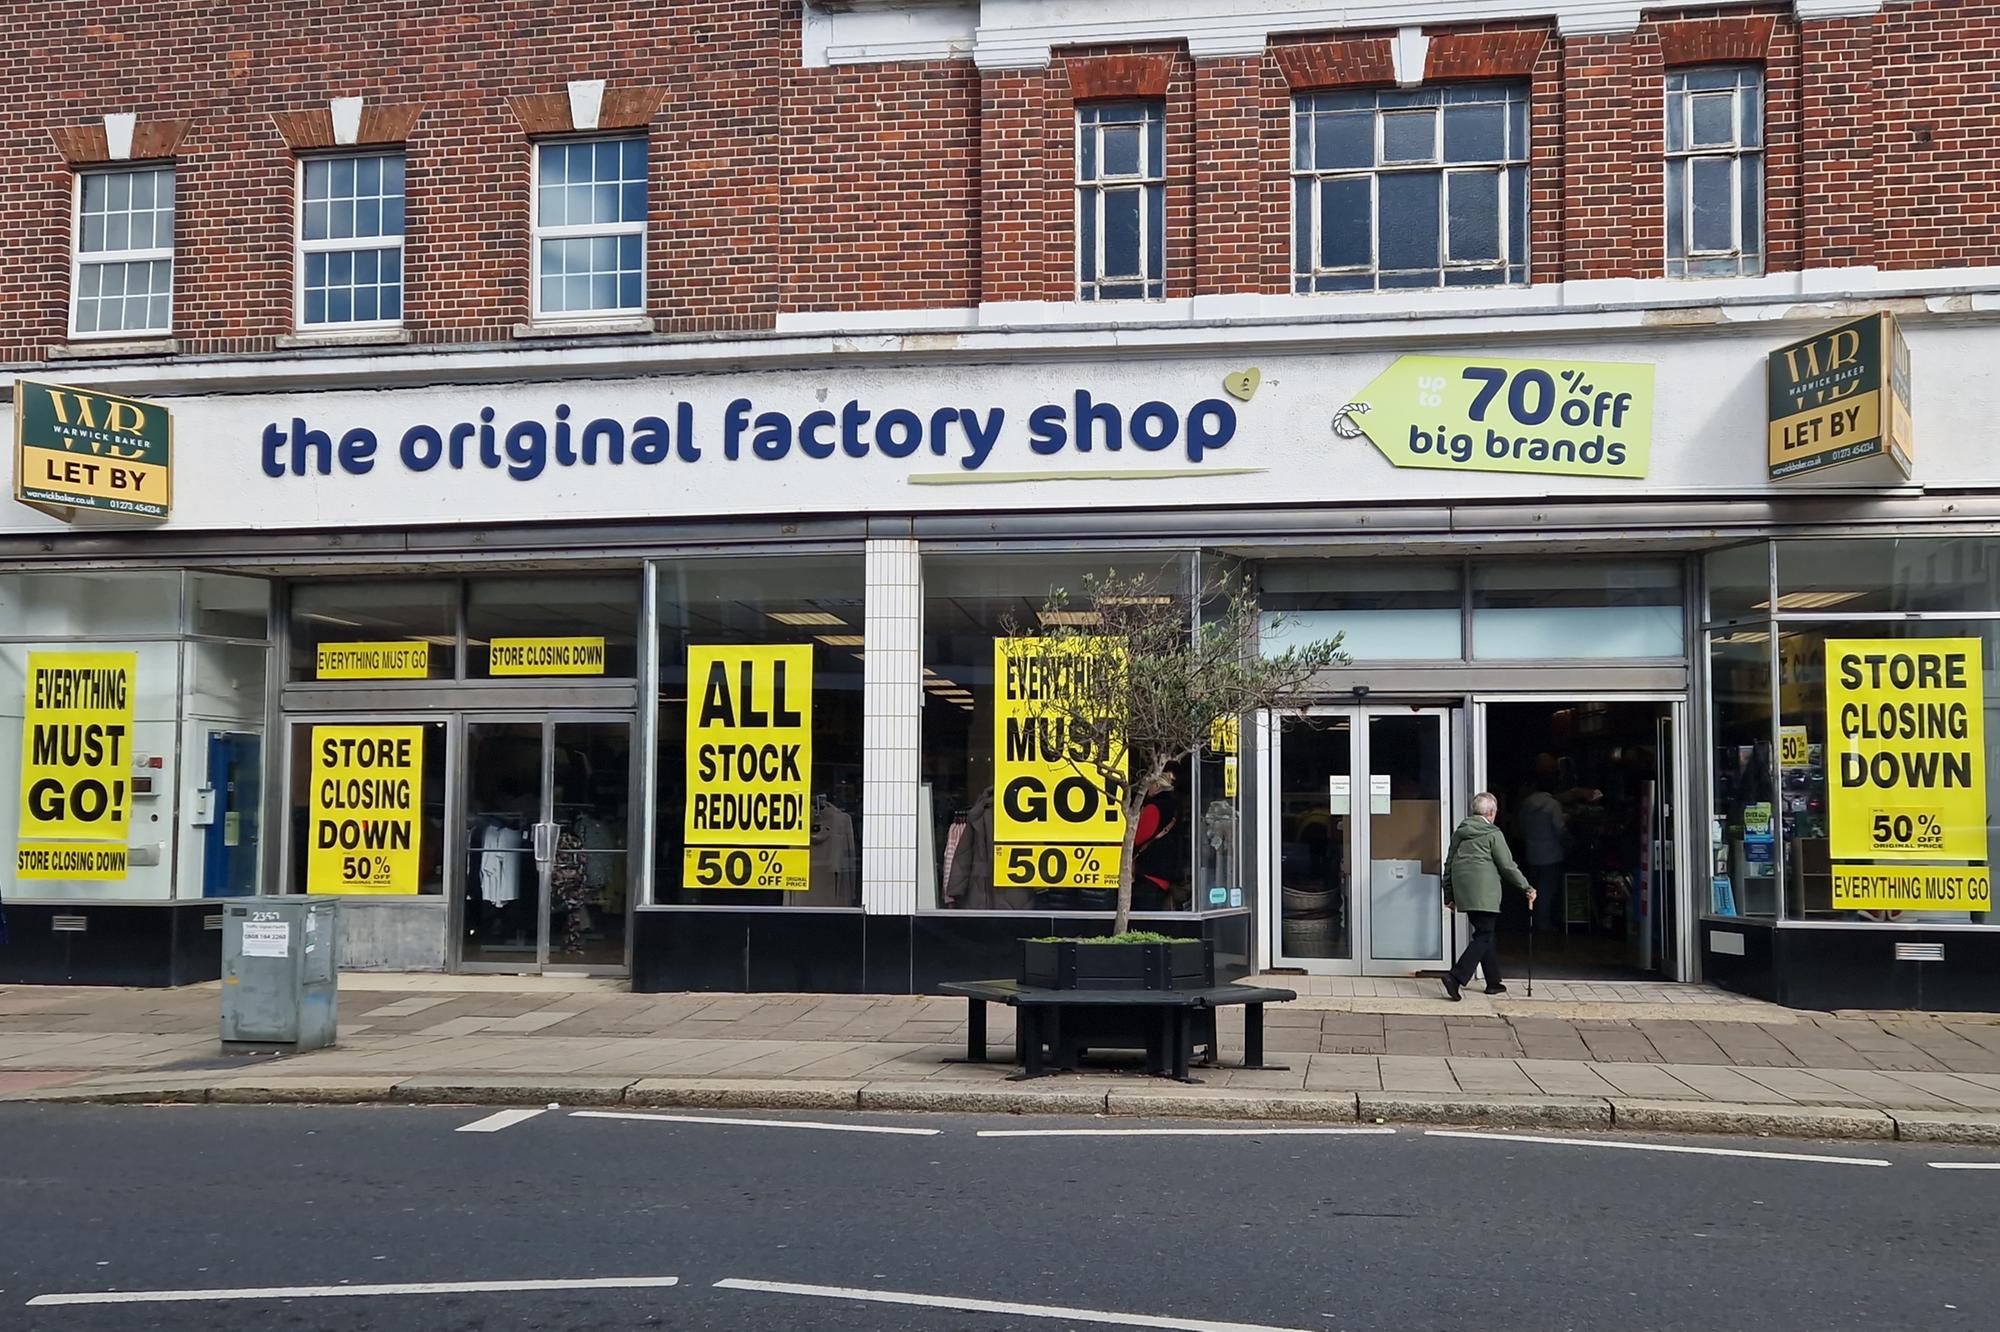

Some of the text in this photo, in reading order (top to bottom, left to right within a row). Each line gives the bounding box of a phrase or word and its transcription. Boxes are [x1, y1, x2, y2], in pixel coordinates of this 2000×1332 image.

[1418, 375, 1446, 391] up
[1789, 365, 1865, 396] WARWICK BAKER
[1419, 393, 1441, 408] to
[1560, 391, 1632, 428] off
[53, 425, 151, 448] WARWICK BAKER
[261, 389, 1237, 482] the original factory shop
[1784, 406, 1861, 450] LET BY
[1409, 424, 1627, 466] big brands
[47, 459, 147, 491] LET BY
[26, 490, 95, 505] warwickbaker.co.uk
[110, 500, 133, 509] 01273
[318, 650, 426, 670] EVERYTHING MUST GO
[492, 645, 602, 666] STORE CLOSING DOWN
[1840, 654, 1967, 689] STORE
[35, 668, 126, 710] EVERYTHING
[698, 660, 801, 728] ALL
[1007, 657, 1118, 700] EVERYTHI
[1841, 702, 1968, 739] CLOSING
[32, 724, 125, 767] MUST
[321, 738, 411, 768] STORE
[698, 744, 801, 782] STOCK
[1841, 752, 1972, 788] DOWN
[28, 778, 125, 822] GO!
[320, 778, 410, 809] CLOSING
[1003, 776, 1121, 823] GO!
[693, 793, 803, 830] REDUCED!
[318, 820, 411, 850] DOWN
[18, 850, 126, 871] STORE CLOSING DOWN
[758, 875, 782, 885] OFF
[1073, 873, 1100, 883] OFF
[1834, 876, 1988, 900] EVERYTHING MUST GO
